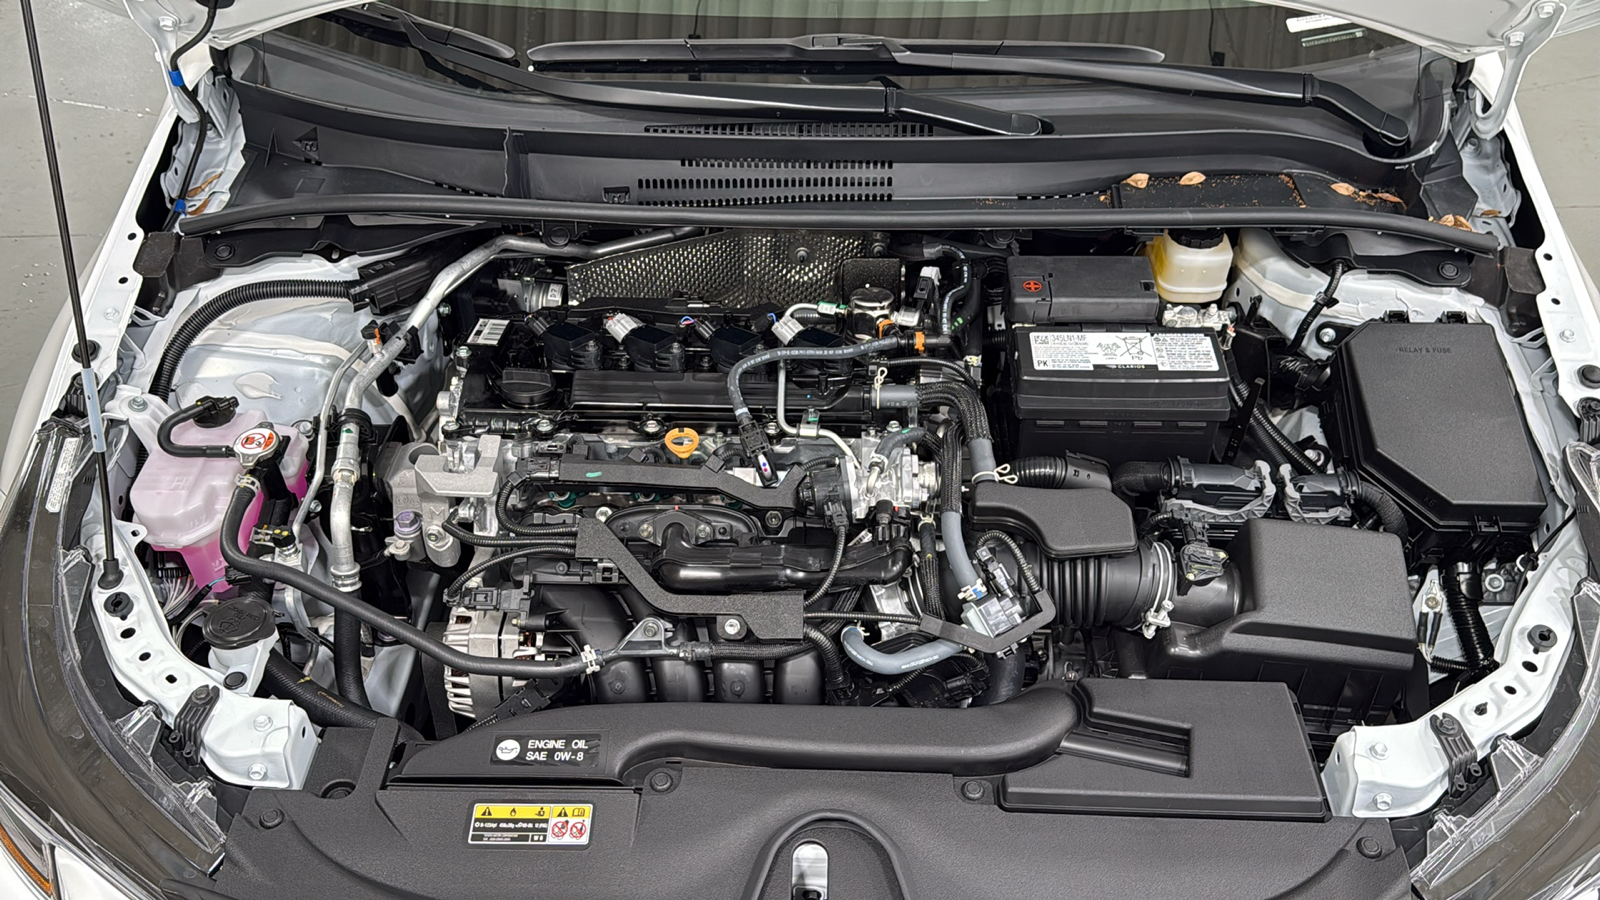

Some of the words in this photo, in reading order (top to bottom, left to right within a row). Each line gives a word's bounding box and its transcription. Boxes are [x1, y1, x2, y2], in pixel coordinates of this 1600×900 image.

[1432, 346, 1453, 354] FUSE
[1037, 359, 1049, 367] PK
[527, 739, 566, 749] ENGINE
[571, 739, 589, 749] OIL
[525, 751, 548, 761] SAE
[553, 751, 584, 761] 0W-8
